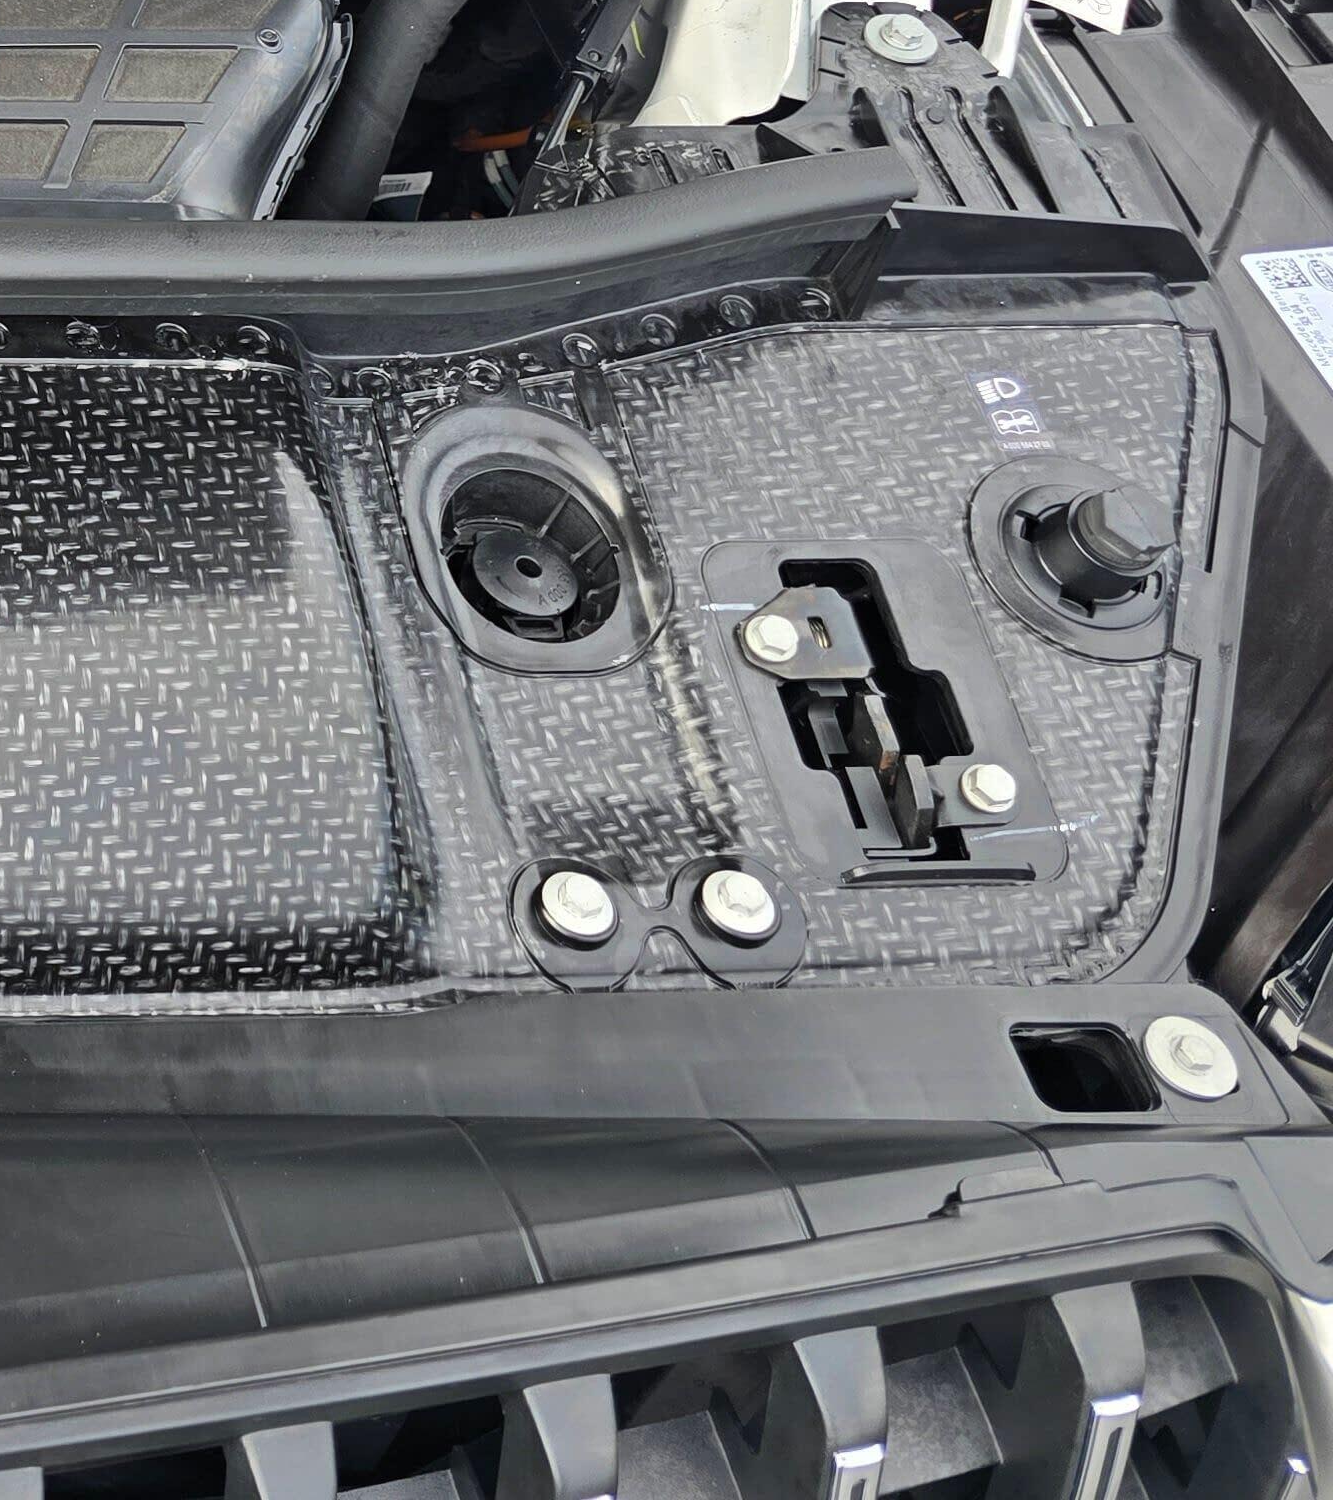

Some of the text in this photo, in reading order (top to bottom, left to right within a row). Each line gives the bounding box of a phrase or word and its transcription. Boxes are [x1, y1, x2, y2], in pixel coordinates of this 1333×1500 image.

[1269, 289, 1292, 312] Benz
[1308, 306, 1323, 321] LED
[1293, 322, 1330, 367] Mercedes
